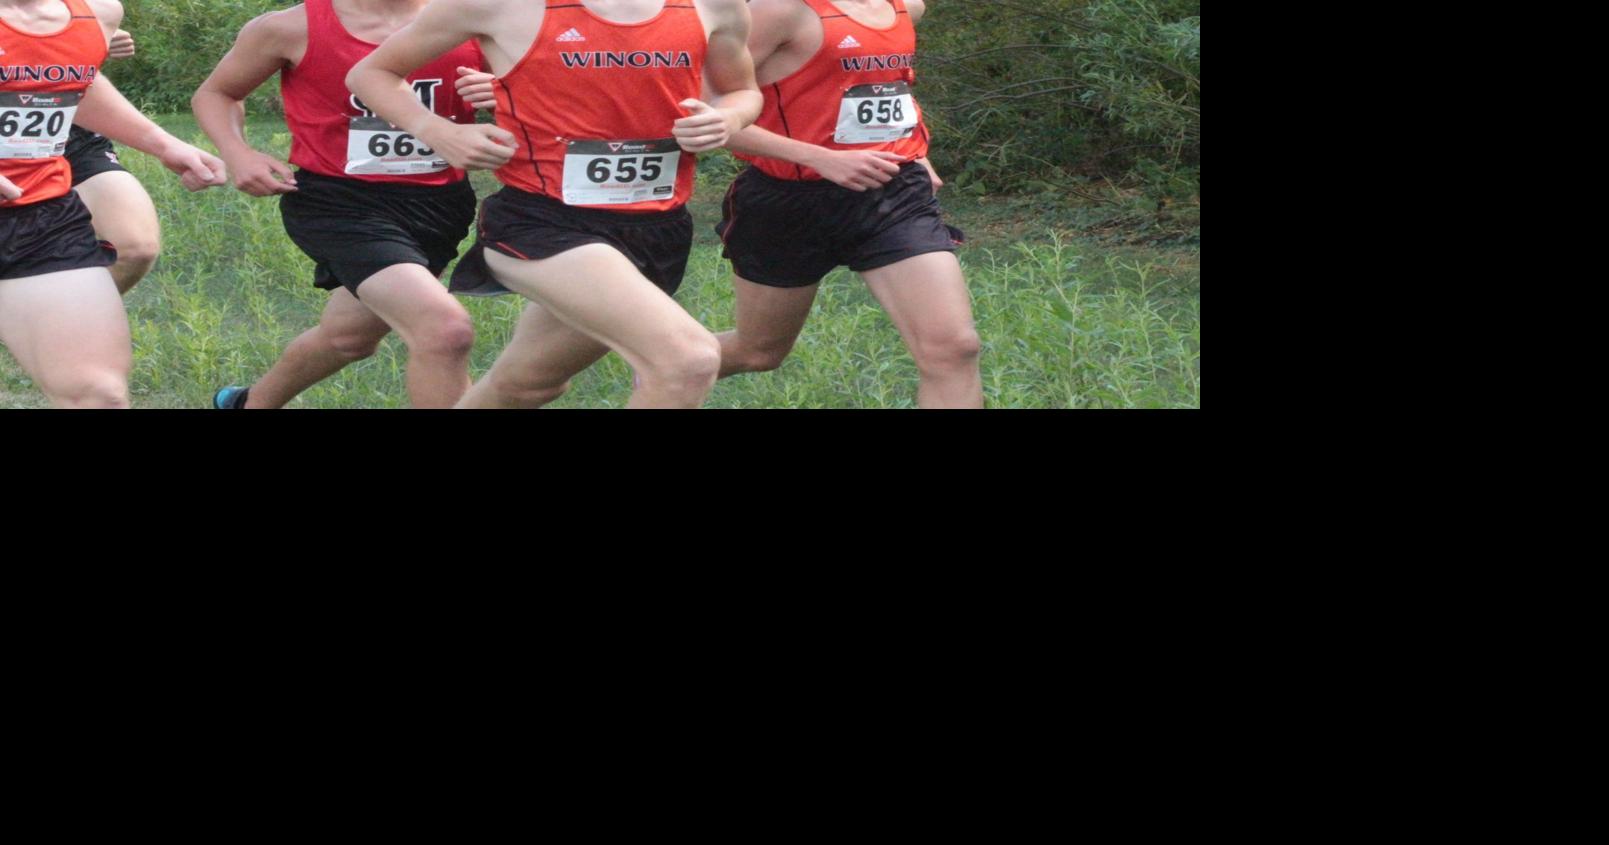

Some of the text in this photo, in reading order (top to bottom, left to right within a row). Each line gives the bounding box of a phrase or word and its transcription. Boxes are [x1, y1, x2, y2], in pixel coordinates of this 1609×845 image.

[559, 51, 692, 69] WINONA
[0, 110, 65, 137] 620
[857, 98, 904, 124] 658
[586, 156, 663, 184] 655
